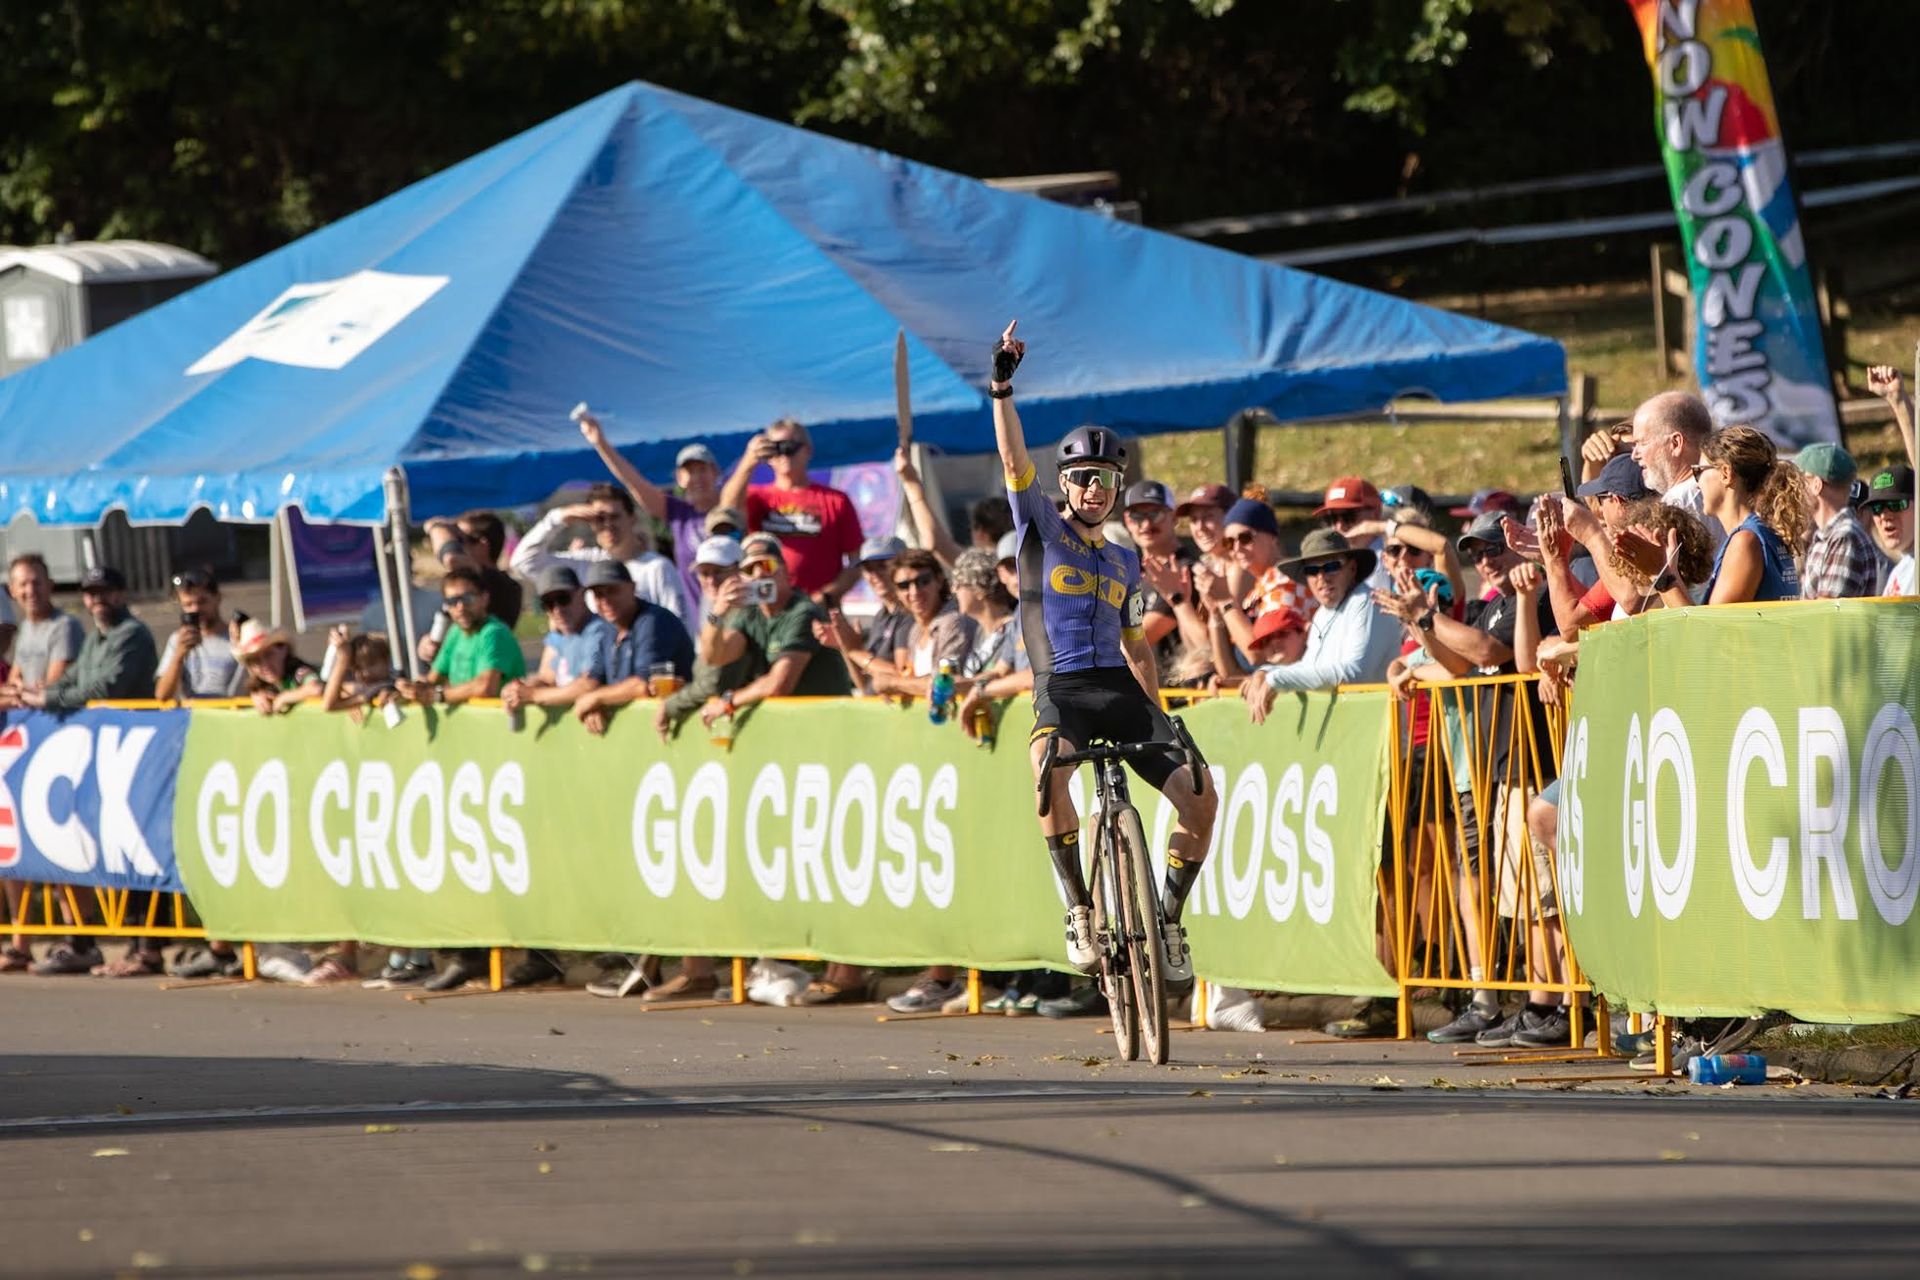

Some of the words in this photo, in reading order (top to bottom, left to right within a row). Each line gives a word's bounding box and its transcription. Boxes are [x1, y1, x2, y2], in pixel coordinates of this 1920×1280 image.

[1683, 162, 1772, 425] CONES
[196, 757, 291, 889] GO
[309, 757, 531, 896] CROSS
[632, 759, 729, 900] GO
[744, 761, 959, 909] CROSS
[1623, 706, 1698, 921] GO
